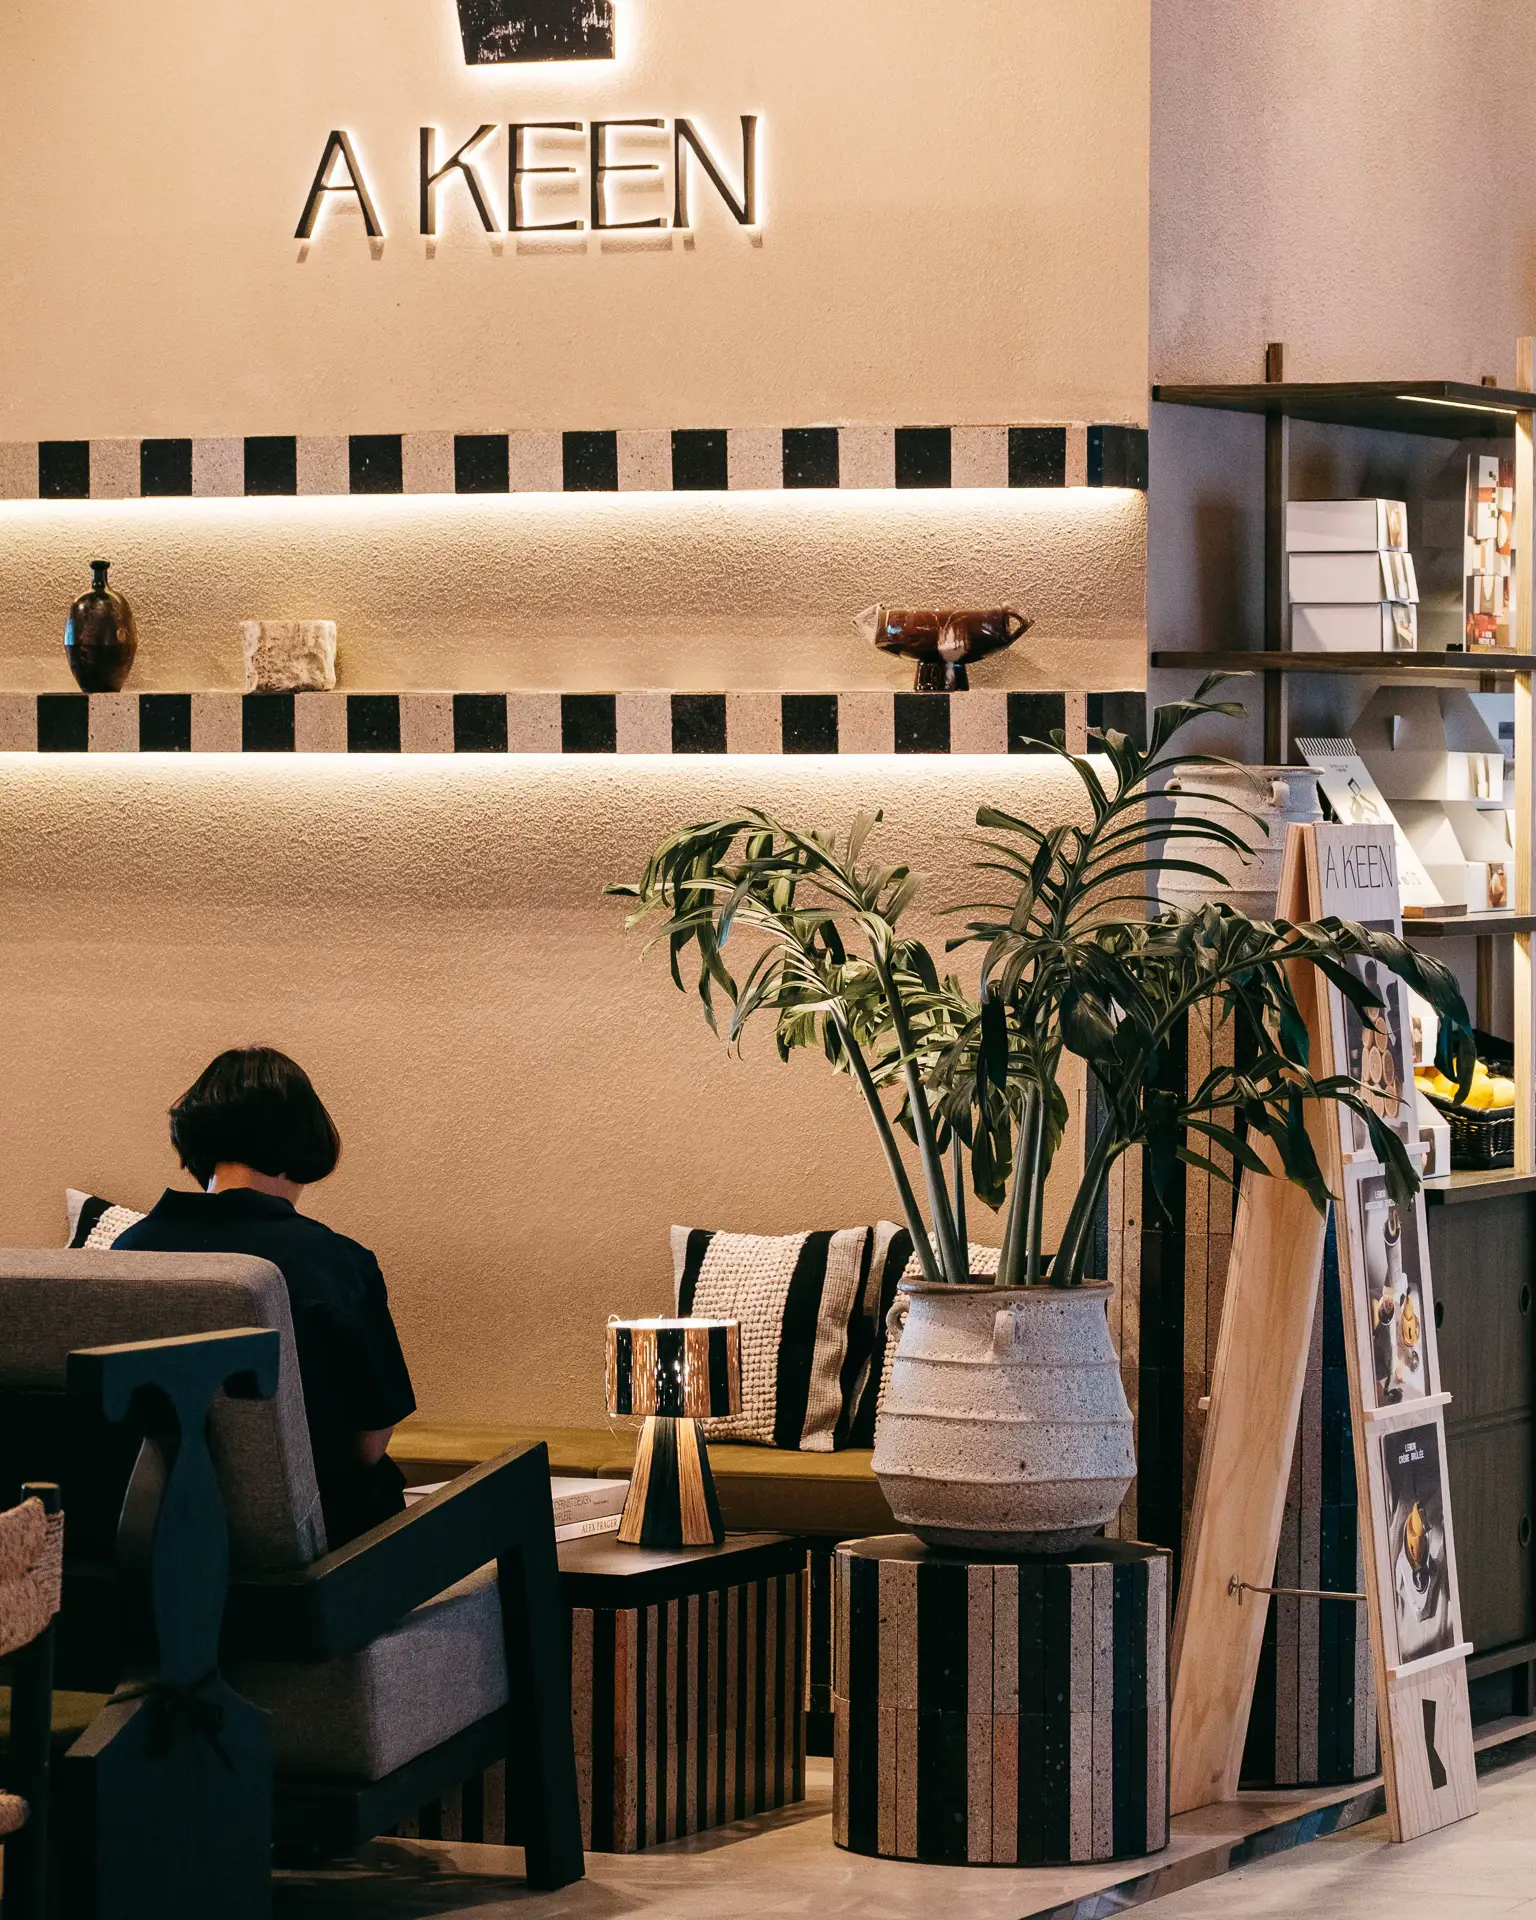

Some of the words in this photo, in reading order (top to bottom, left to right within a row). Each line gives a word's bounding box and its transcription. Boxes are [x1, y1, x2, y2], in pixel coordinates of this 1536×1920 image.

[294, 130, 384, 239] A
[420, 115, 758, 235] KEEN
[1325, 845, 1340, 889] A
[1342, 845, 1393, 889] KEEN
[581, 1521, 596, 1535] ALEX
[596, 1518, 618, 1531] PRAGER
